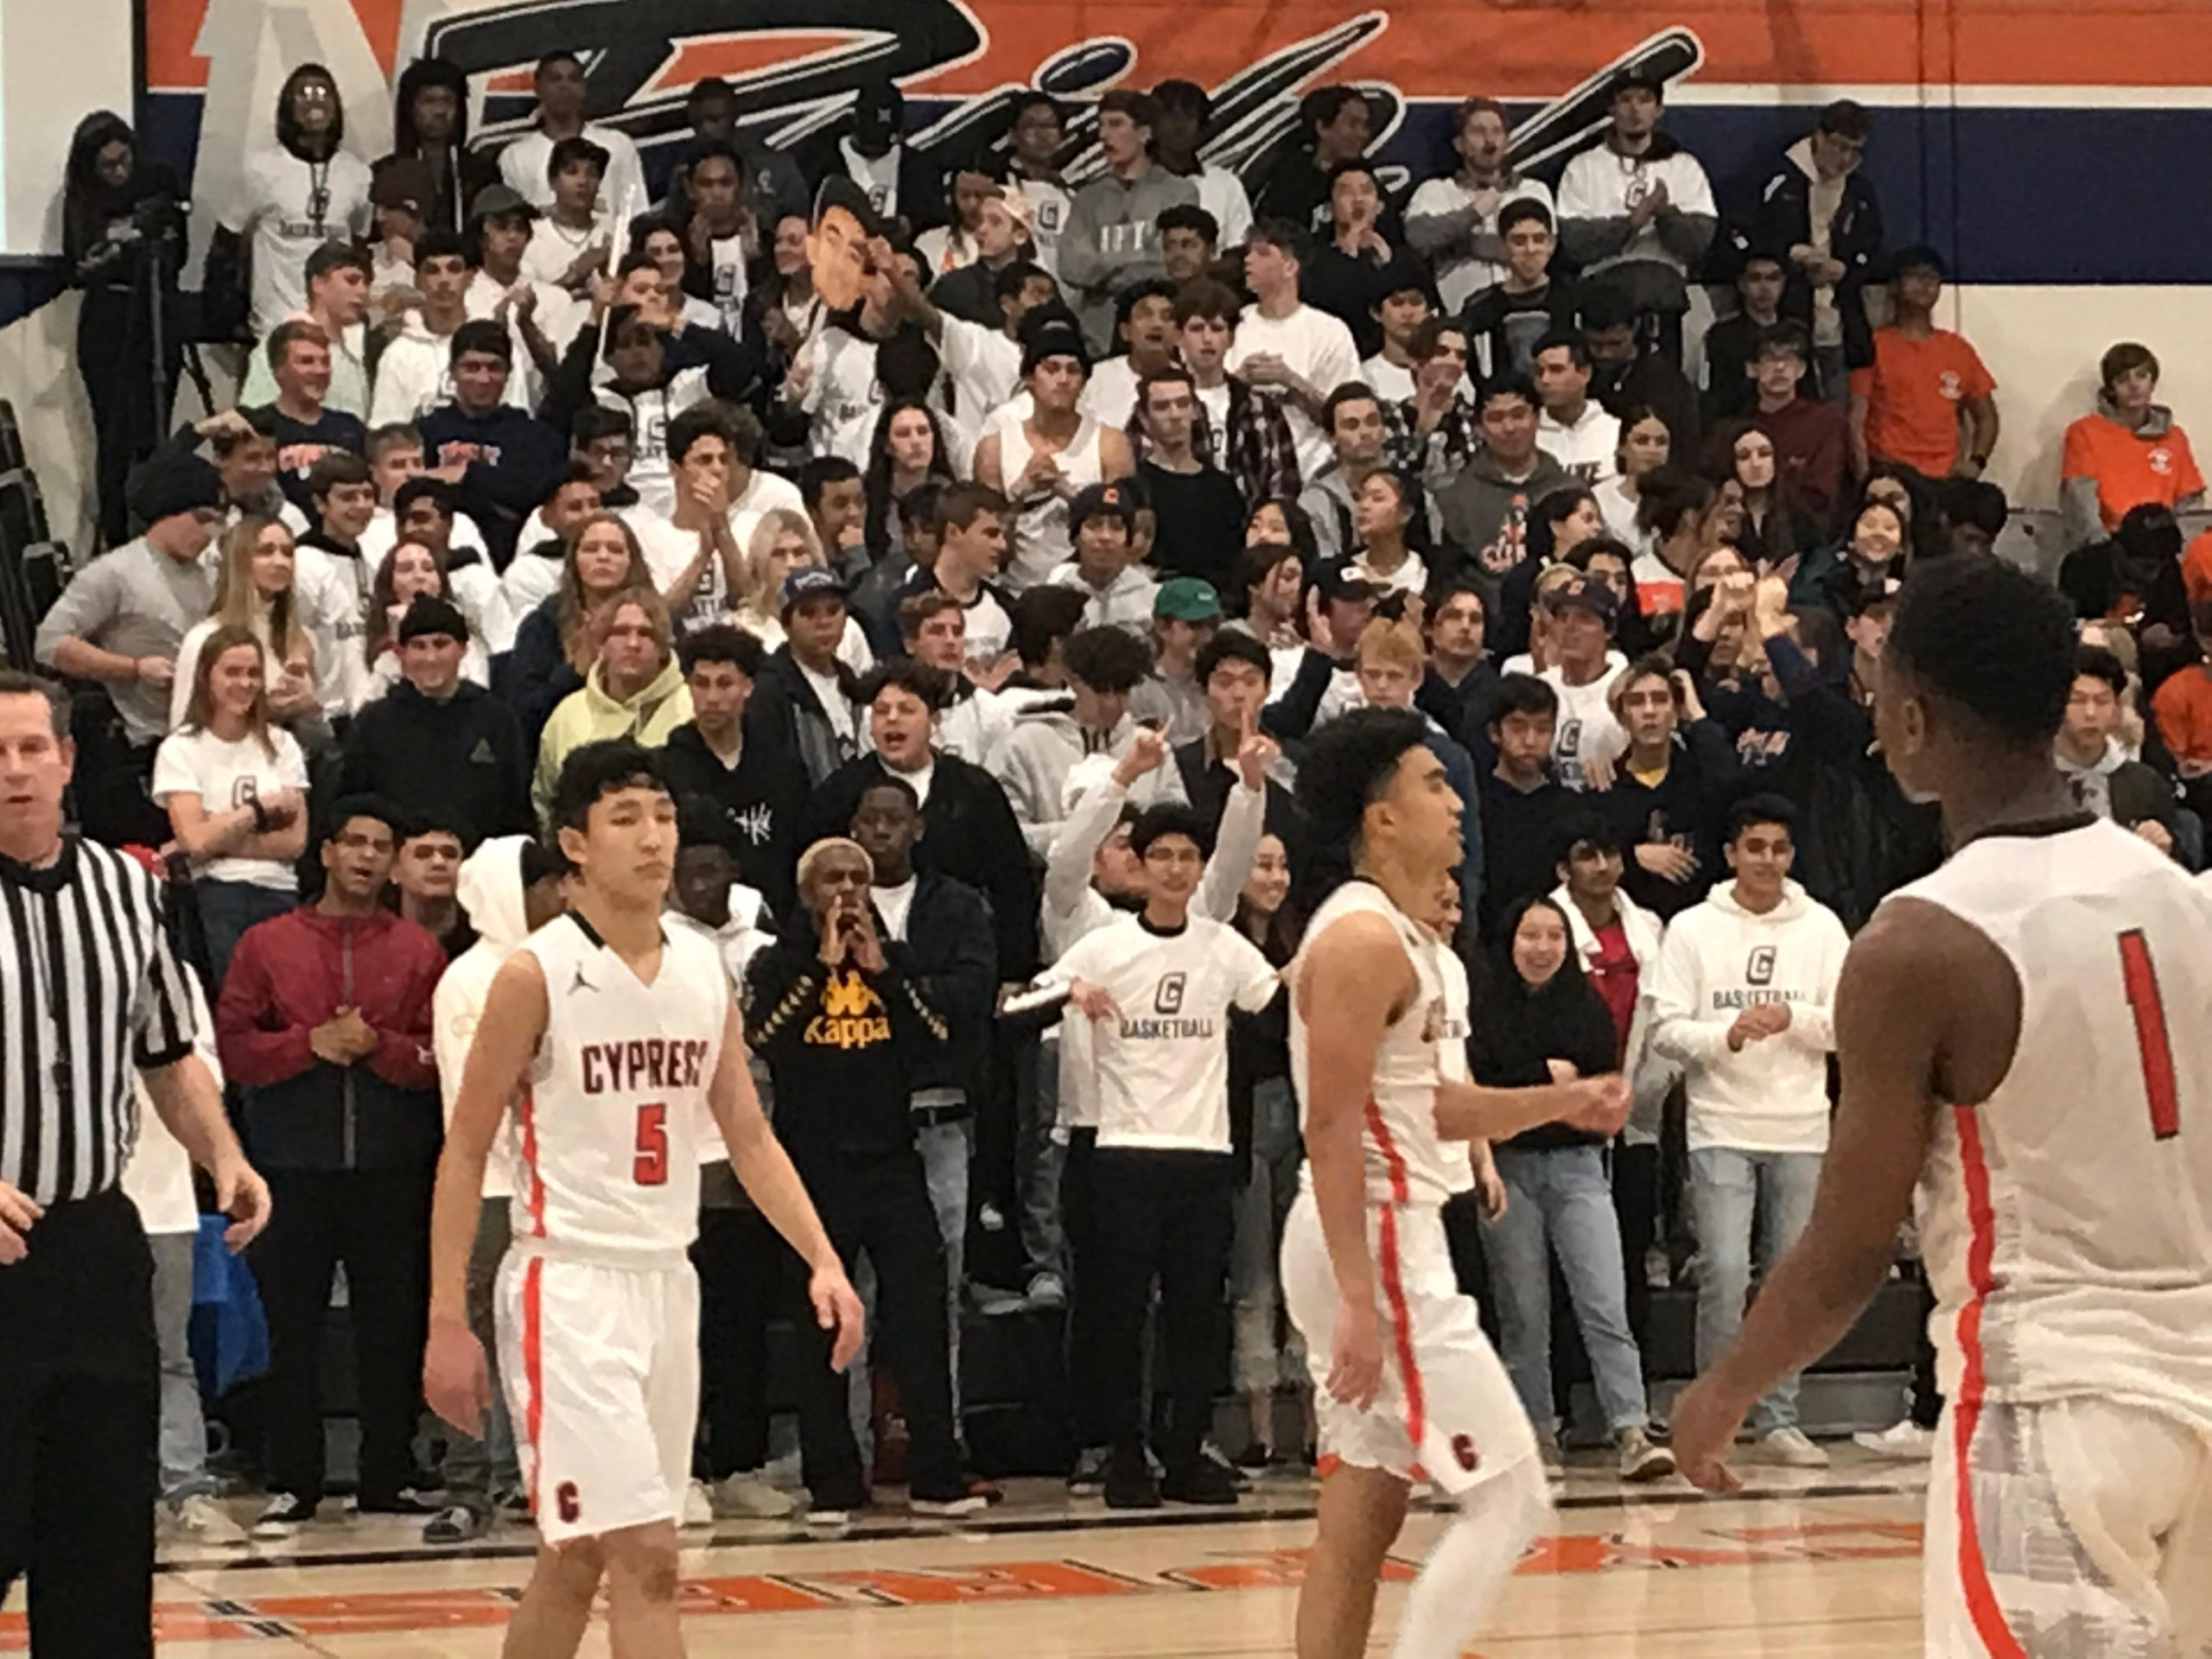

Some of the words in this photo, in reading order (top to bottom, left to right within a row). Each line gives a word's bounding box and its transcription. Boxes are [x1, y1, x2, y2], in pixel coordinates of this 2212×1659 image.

[804, 1015, 891, 1049] Kappa
[1120, 1018, 1213, 1039] BASKETBALL
[2117, 927, 2180, 1141] 1
[632, 1102, 668, 1185] 5
